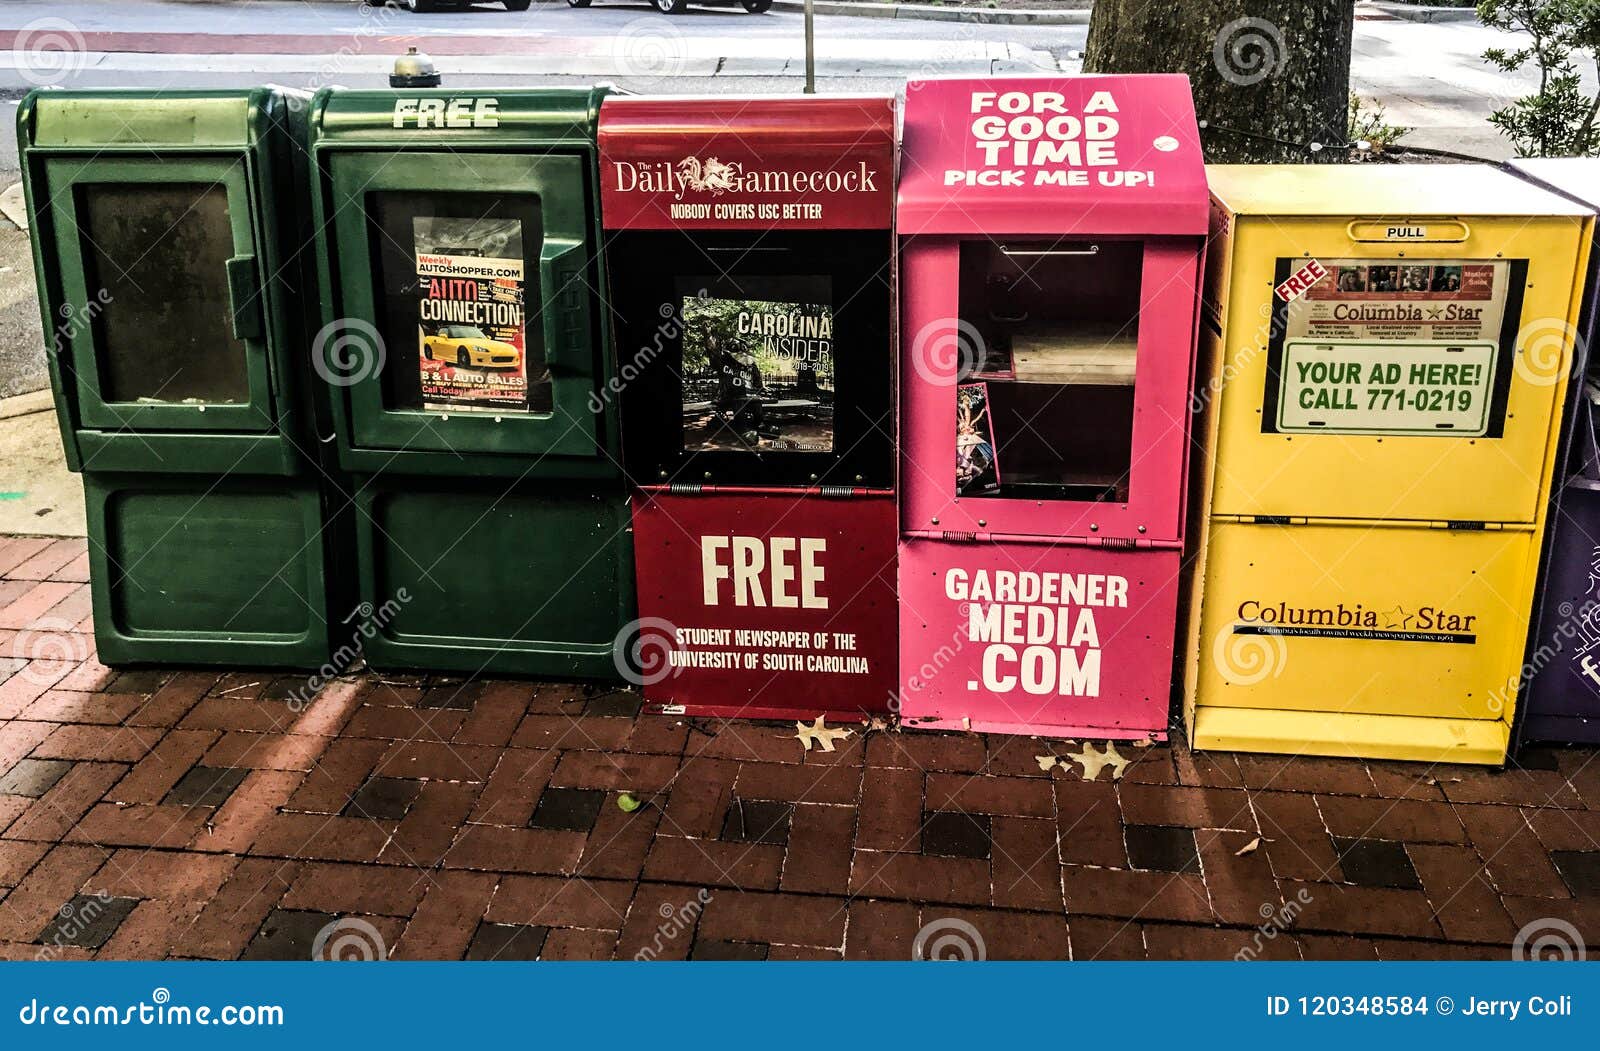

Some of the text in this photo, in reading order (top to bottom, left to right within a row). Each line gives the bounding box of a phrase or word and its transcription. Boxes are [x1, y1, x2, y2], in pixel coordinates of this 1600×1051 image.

[393, 98, 499, 128] FREE
[970, 91, 1120, 114] FOR A
[971, 115, 1120, 141] GOOD
[975, 140, 1119, 166] TIME
[613, 161, 878, 200] The Daily Gamecock
[943, 169, 1155, 187] PICK ME UP!
[670, 203, 822, 220] NOBODY COVERS USC BETTER
[1387, 227, 1425, 238] PULL
[419, 255, 452, 266] Weekly
[419, 264, 520, 278] AUTOSHOPPER.COM
[429, 278, 477, 300] AUTO
[1276, 260, 1325, 302] FREE
[420, 298, 520, 326] CONNECTION
[1334, 303, 1423, 321] Columbia
[1445, 303, 1483, 321] Star
[738, 311, 831, 339] CAROLINA
[764, 336, 830, 362] INSIDER
[422, 371, 524, 386] B & L AUTO SALES
[1297, 362, 1482, 386] YOUR AD HERE!
[422, 385, 438, 393] Call
[439, 386, 467, 396] Today!
[1298, 388, 1472, 412] CALL 771-0219
[701, 535, 829, 609] FREE
[945, 568, 1129, 608] GARDENER
[968, 602, 1100, 648] MEDIA
[1237, 600, 1476, 632] Columbia Star
[676, 628, 856, 650] STUDENT NEWSPAPER OF THE
[1257, 626, 1298, 635] Columbia's
[1322, 629, 1349, 637] owned
[1349, 629, 1374, 639] weekly
[1374, 631, 1416, 640] newspaper
[1416, 633, 1436, 641] since
[669, 650, 869, 674] UNIVERSITY OF SOUTH CAROLINA
[967, 644, 1101, 697] .COM
